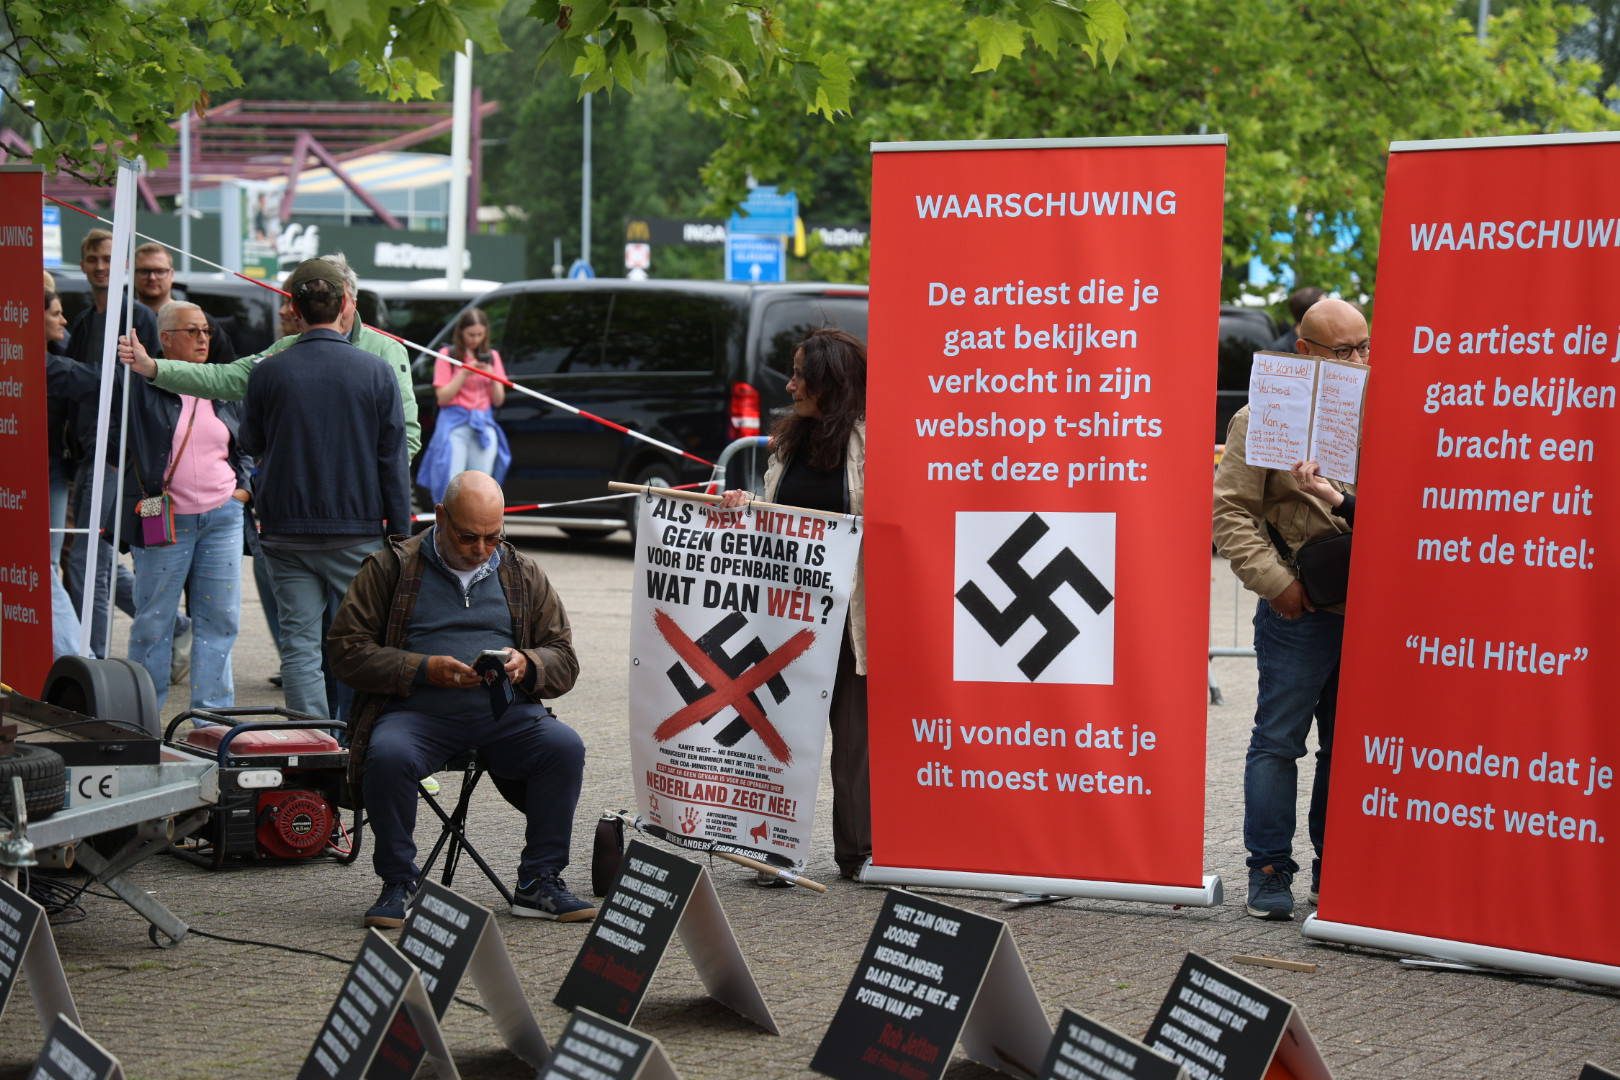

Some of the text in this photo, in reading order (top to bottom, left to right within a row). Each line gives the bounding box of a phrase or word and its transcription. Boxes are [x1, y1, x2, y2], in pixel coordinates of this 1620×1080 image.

[916, 190, 1176, 218] WAARSCHUWING
[0, 226, 33, 247] UWING
[1411, 219, 1620, 251] WAARSCHUWI
[929, 279, 1158, 311] De artiest die je
[3, 302, 29, 333] die je
[0, 337, 23, 365] ijken
[944, 323, 1136, 356] gaat bekijken
[1413, 325, 1607, 354] De artiest die
[0, 377, 23, 398] erder
[928, 367, 1150, 399] verkocht in zijn
[1424, 377, 1615, 416] gaat bekijken
[0, 413, 18, 435] ard:
[916, 411, 1162, 443] webshop t-shirts
[1437, 428, 1593, 461] bracht een
[928, 456, 1147, 488] met deze print:
[0, 489, 27, 510] itler.”
[651, 498, 694, 525] ALS
[1423, 485, 1593, 515] nummer uit
[661, 525, 826, 567] GEEN GEVAAR IS
[1418, 535, 1594, 569] met de titel:
[10, 565, 38, 593] dat je
[647, 546, 834, 593] VOOR DE OPENBARE ORDE,
[646, 569, 834, 625] WAT DAN WÉL ?
[3, 604, 39, 625] weten.
[1406, 635, 1588, 675] “Heil Hitler”
[696, 745, 710, 753] WEST
[912, 719, 1156, 756] Wij vonden dat je
[917, 762, 1151, 794] dit moest weten.
[1365, 736, 1612, 795] Wij vonden dat je
[78, 774, 112, 799] CE
[646, 769, 797, 817] NEDERLAND ZEGT NEE!
[1363, 787, 1604, 843] dit moest weten.
[734, 846, 768, 861] FASCISME
[883, 925, 920, 948] JOODSE
[914, 911, 935, 929] ZIJN
[934, 916, 961, 937] ONZE
[874, 946, 945, 985] NEDERLANDERS,
[855, 987, 886, 1012] POTEN
[885, 997, 905, 1015] VAN
[865, 966, 960, 1011] DAAR BLIJF JE MET JE
